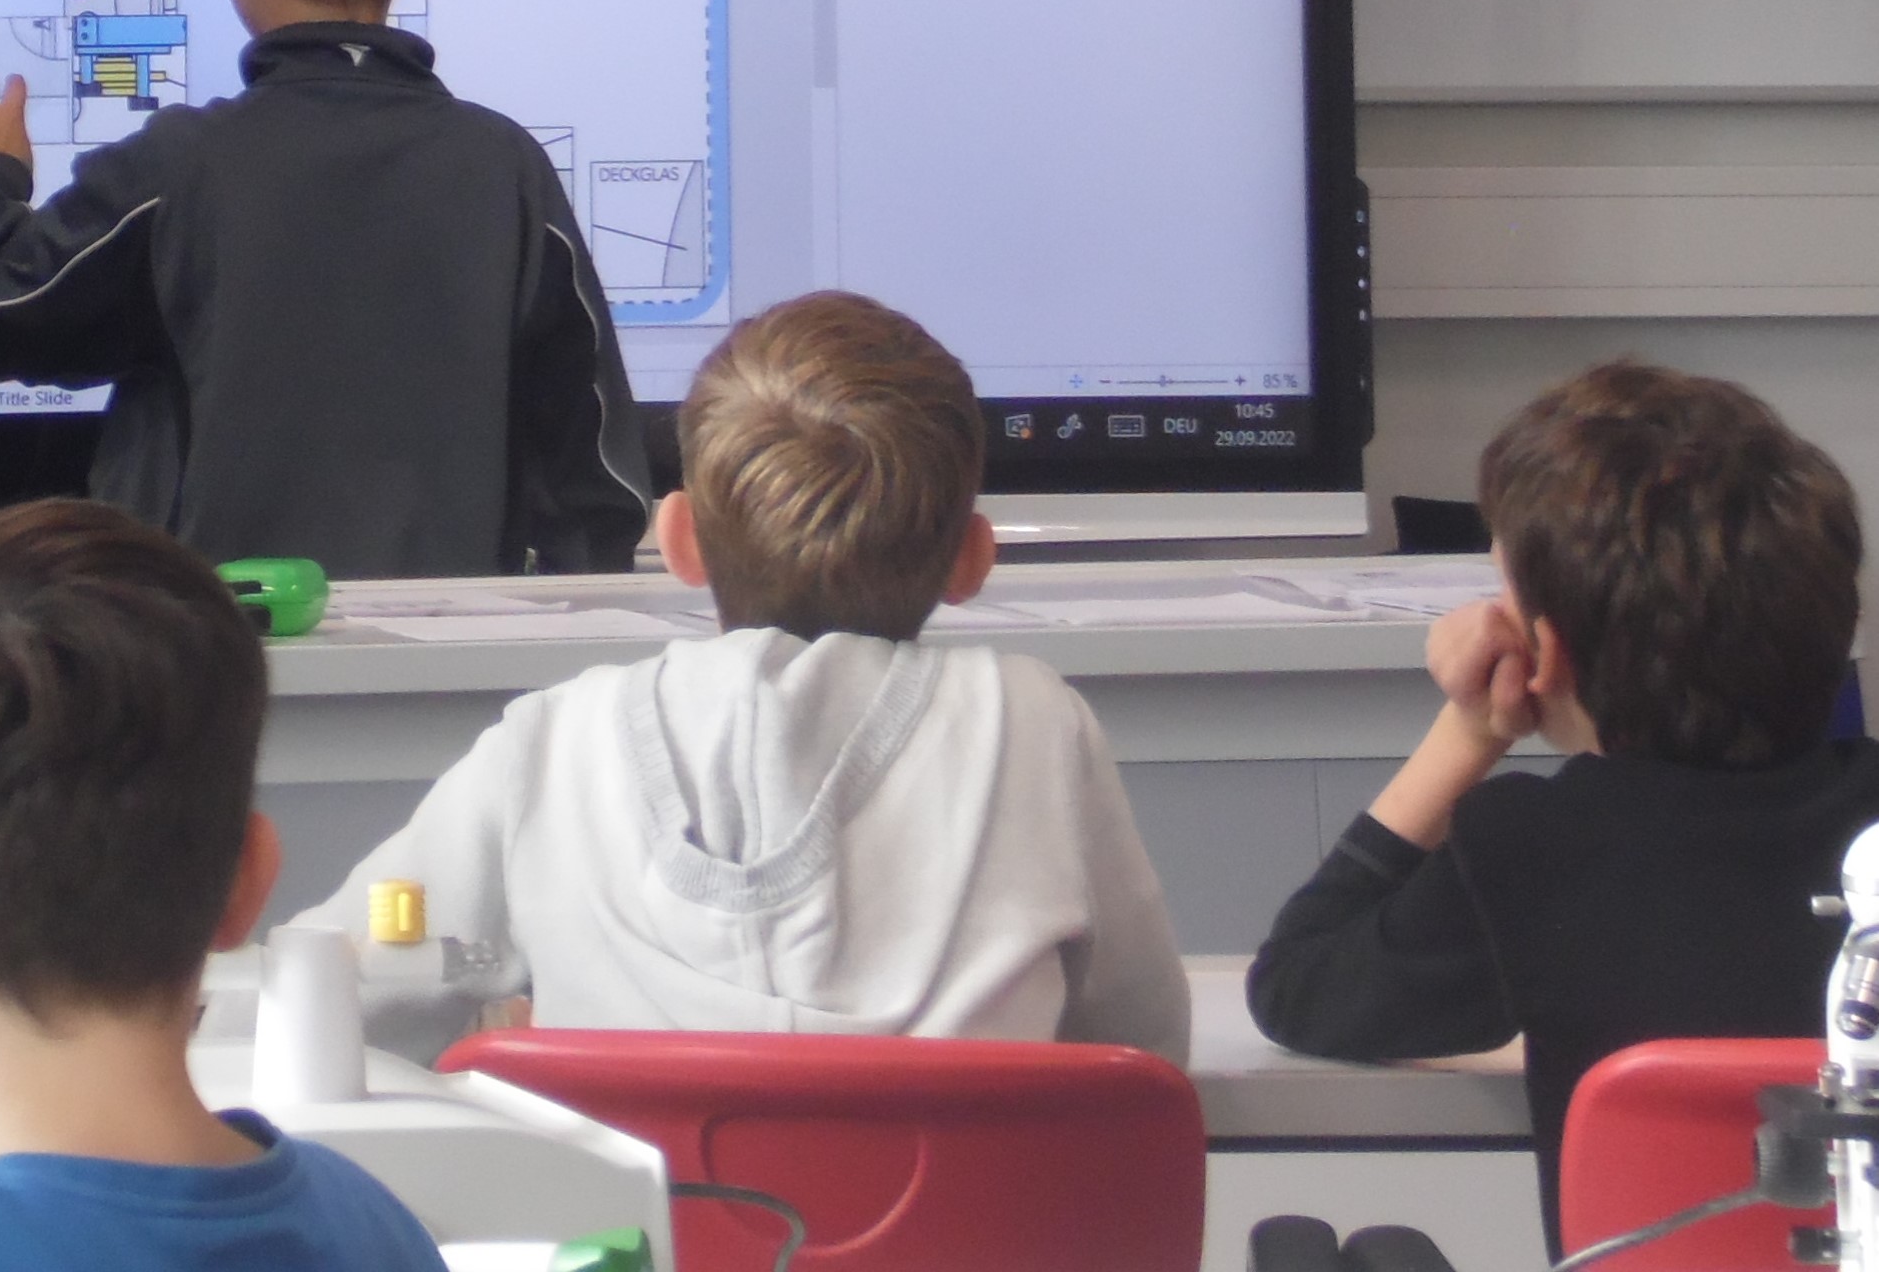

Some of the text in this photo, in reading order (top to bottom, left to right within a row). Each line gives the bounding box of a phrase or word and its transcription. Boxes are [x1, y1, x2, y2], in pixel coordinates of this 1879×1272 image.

[599, 167, 680, 182] DECKGLAS
[35, 390, 73, 405] Slide
[1235, 404, 1274, 418] 10:45
[1163, 418, 1198, 434] DEU
[1215, 431, 1296, 446] 29.09.2022
